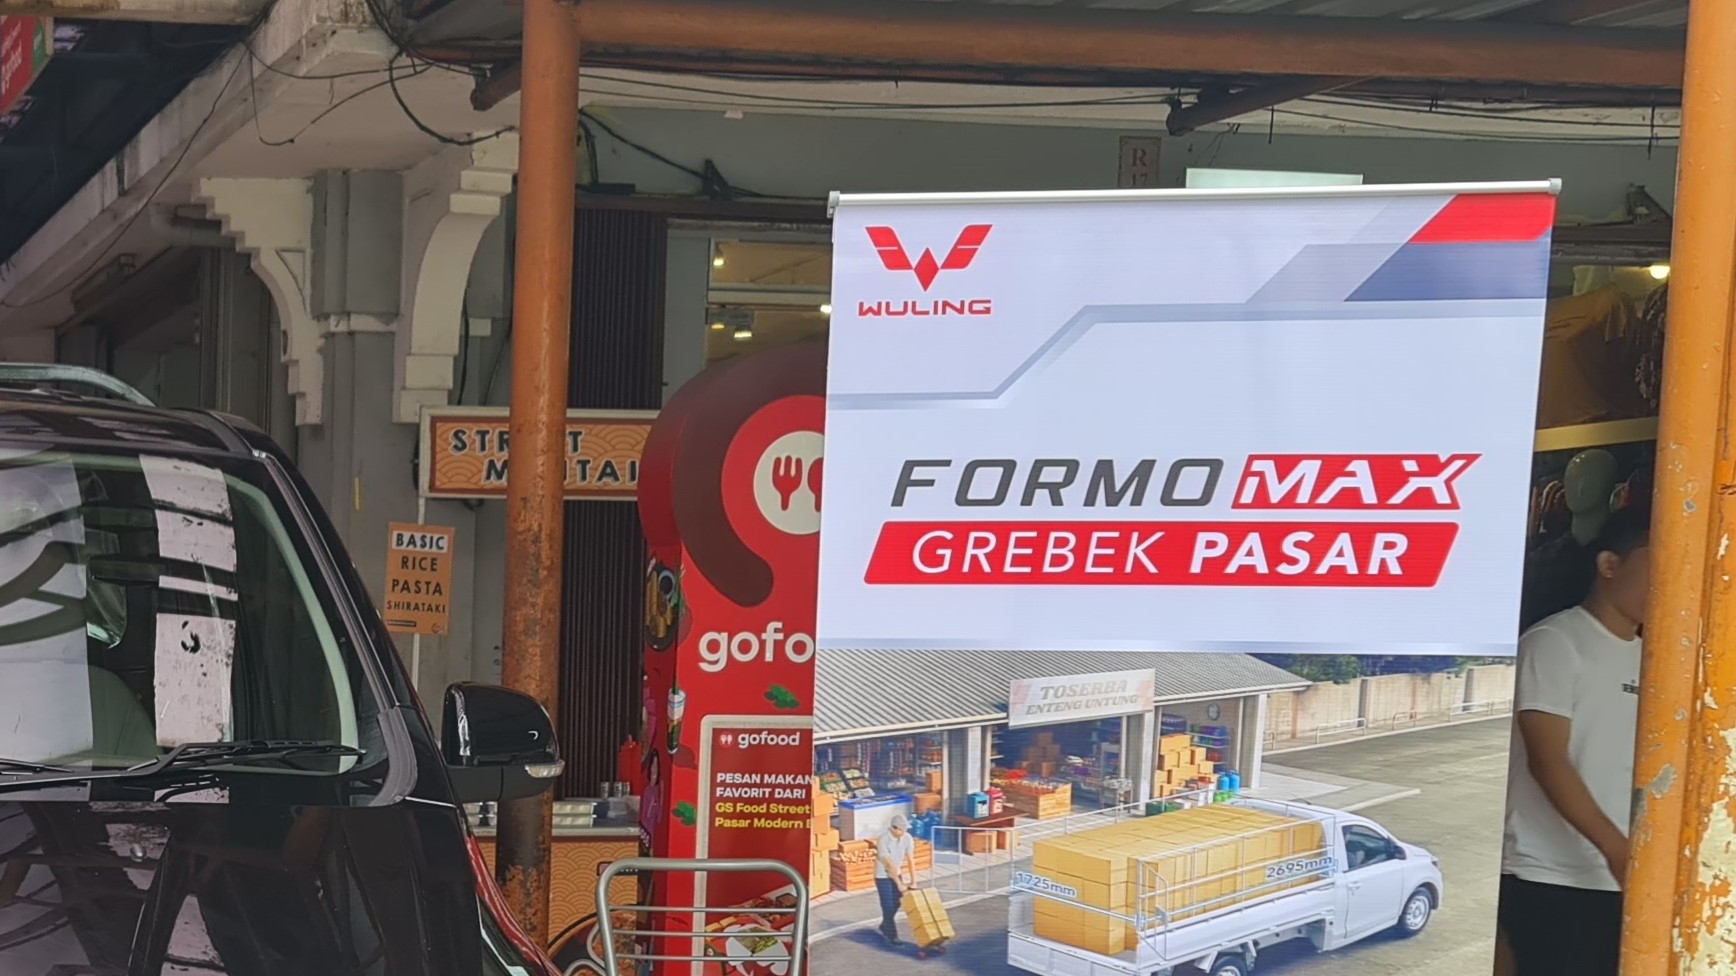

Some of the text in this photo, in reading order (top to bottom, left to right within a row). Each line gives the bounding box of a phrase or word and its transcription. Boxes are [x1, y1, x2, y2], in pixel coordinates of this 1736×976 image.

[1132, 147, 1147, 167] R
[858, 299, 992, 317] WULING
[452, 429, 583, 454] STRT
[485, 459, 637, 483] MTAI
[890, 458, 1470, 508] FORMO MAX
[395, 533, 445, 550] BASIC
[912, 530, 1410, 575] GREBEK PASAR
[401, 555, 438, 572] RICE
[391, 579, 443, 596] PASTA
[386, 601, 446, 613] SHIRATAKI
[698, 621, 815, 673] gofo
[1040, 679, 1128, 701] TOSERBA
[1025, 694, 1139, 715] ENTENG UNTUNG
[737, 731, 801, 748] gofood
[716, 773, 813, 785] PESAN MAKAN
[715, 787, 806, 799] FAVORIT DARI
[715, 802, 811, 814] GS Food Street
[715, 817, 751, 828] Pasar
[753, 818, 804, 829] Modern
[1266, 854, 1334, 879] 2695mm
[1016, 871, 1077, 898] 1725mm
